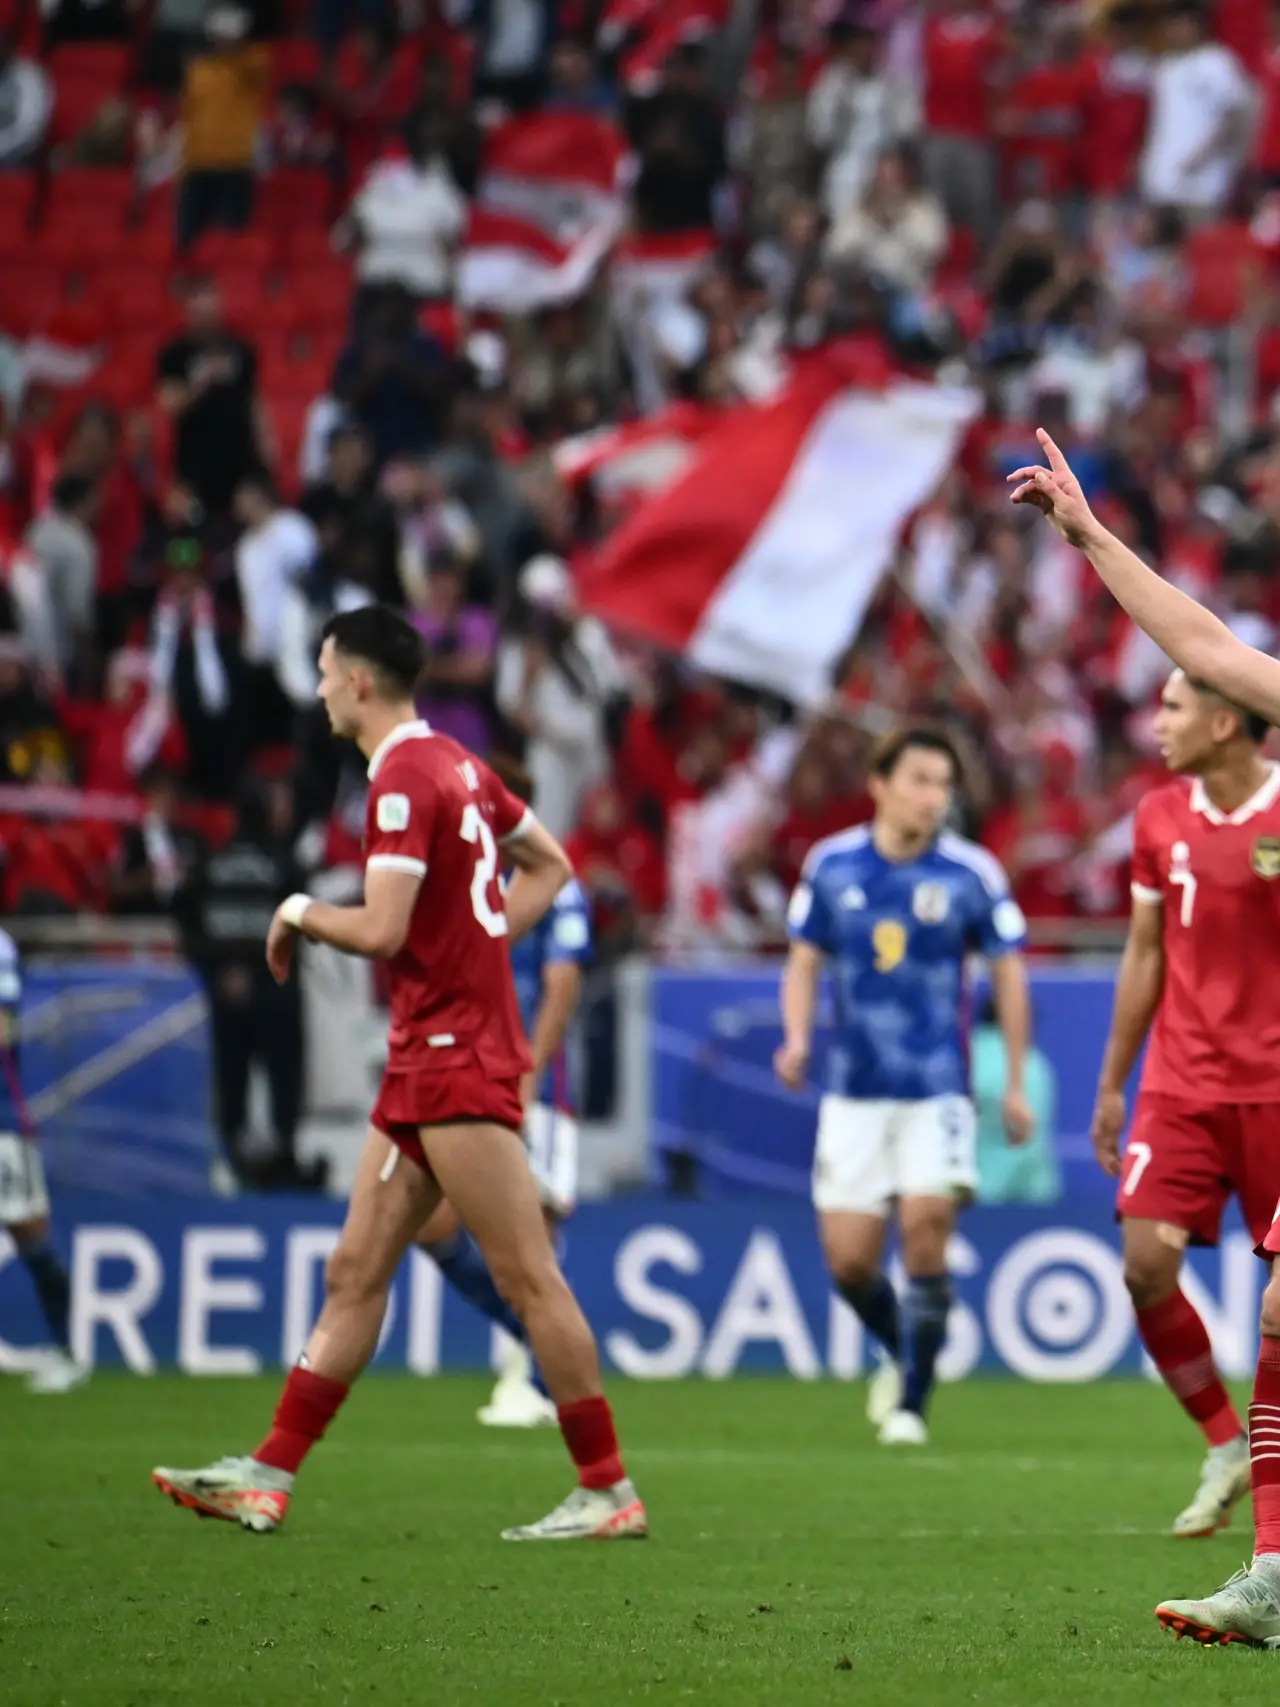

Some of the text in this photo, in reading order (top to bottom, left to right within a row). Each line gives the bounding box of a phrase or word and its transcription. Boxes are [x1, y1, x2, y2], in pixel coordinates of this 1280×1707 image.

[1168, 870, 1198, 928] 7
[872, 918, 908, 974] 9
[1123, 1142, 1152, 1197] 7
